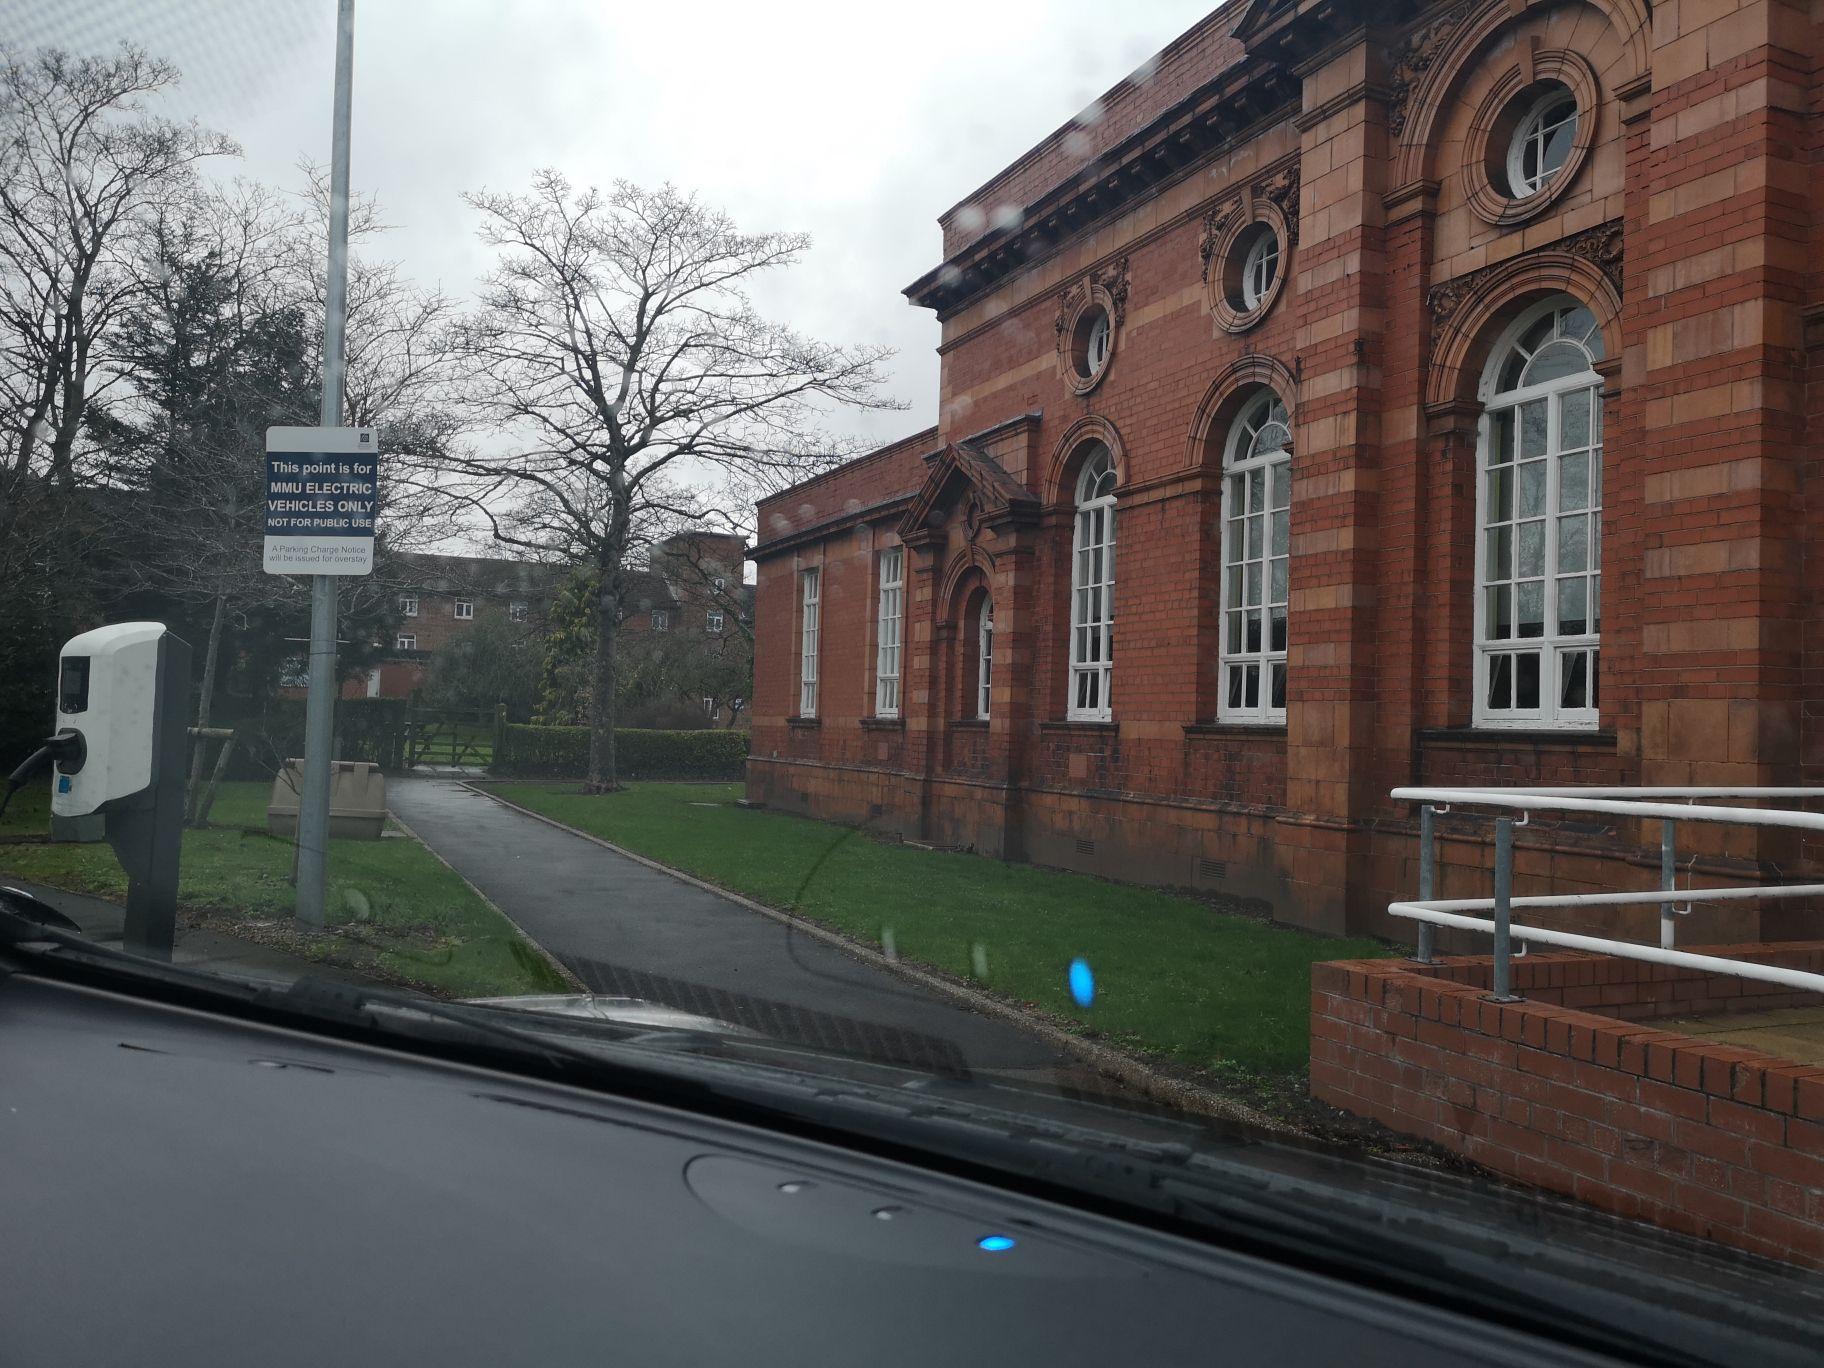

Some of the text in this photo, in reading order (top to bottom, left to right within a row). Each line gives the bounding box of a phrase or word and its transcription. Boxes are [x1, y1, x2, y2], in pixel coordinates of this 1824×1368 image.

[272, 462, 372, 475] This point is for
[271, 482, 372, 494] MMU ELECTRIC
[268, 500, 373, 512] VEHICLES ONLY
[291, 519, 311, 527] FOR
[314, 519, 349, 527] PUBLIC
[352, 519, 371, 527] USE
[280, 545, 308, 554] Parking
[311, 546, 339, 554] Charge
